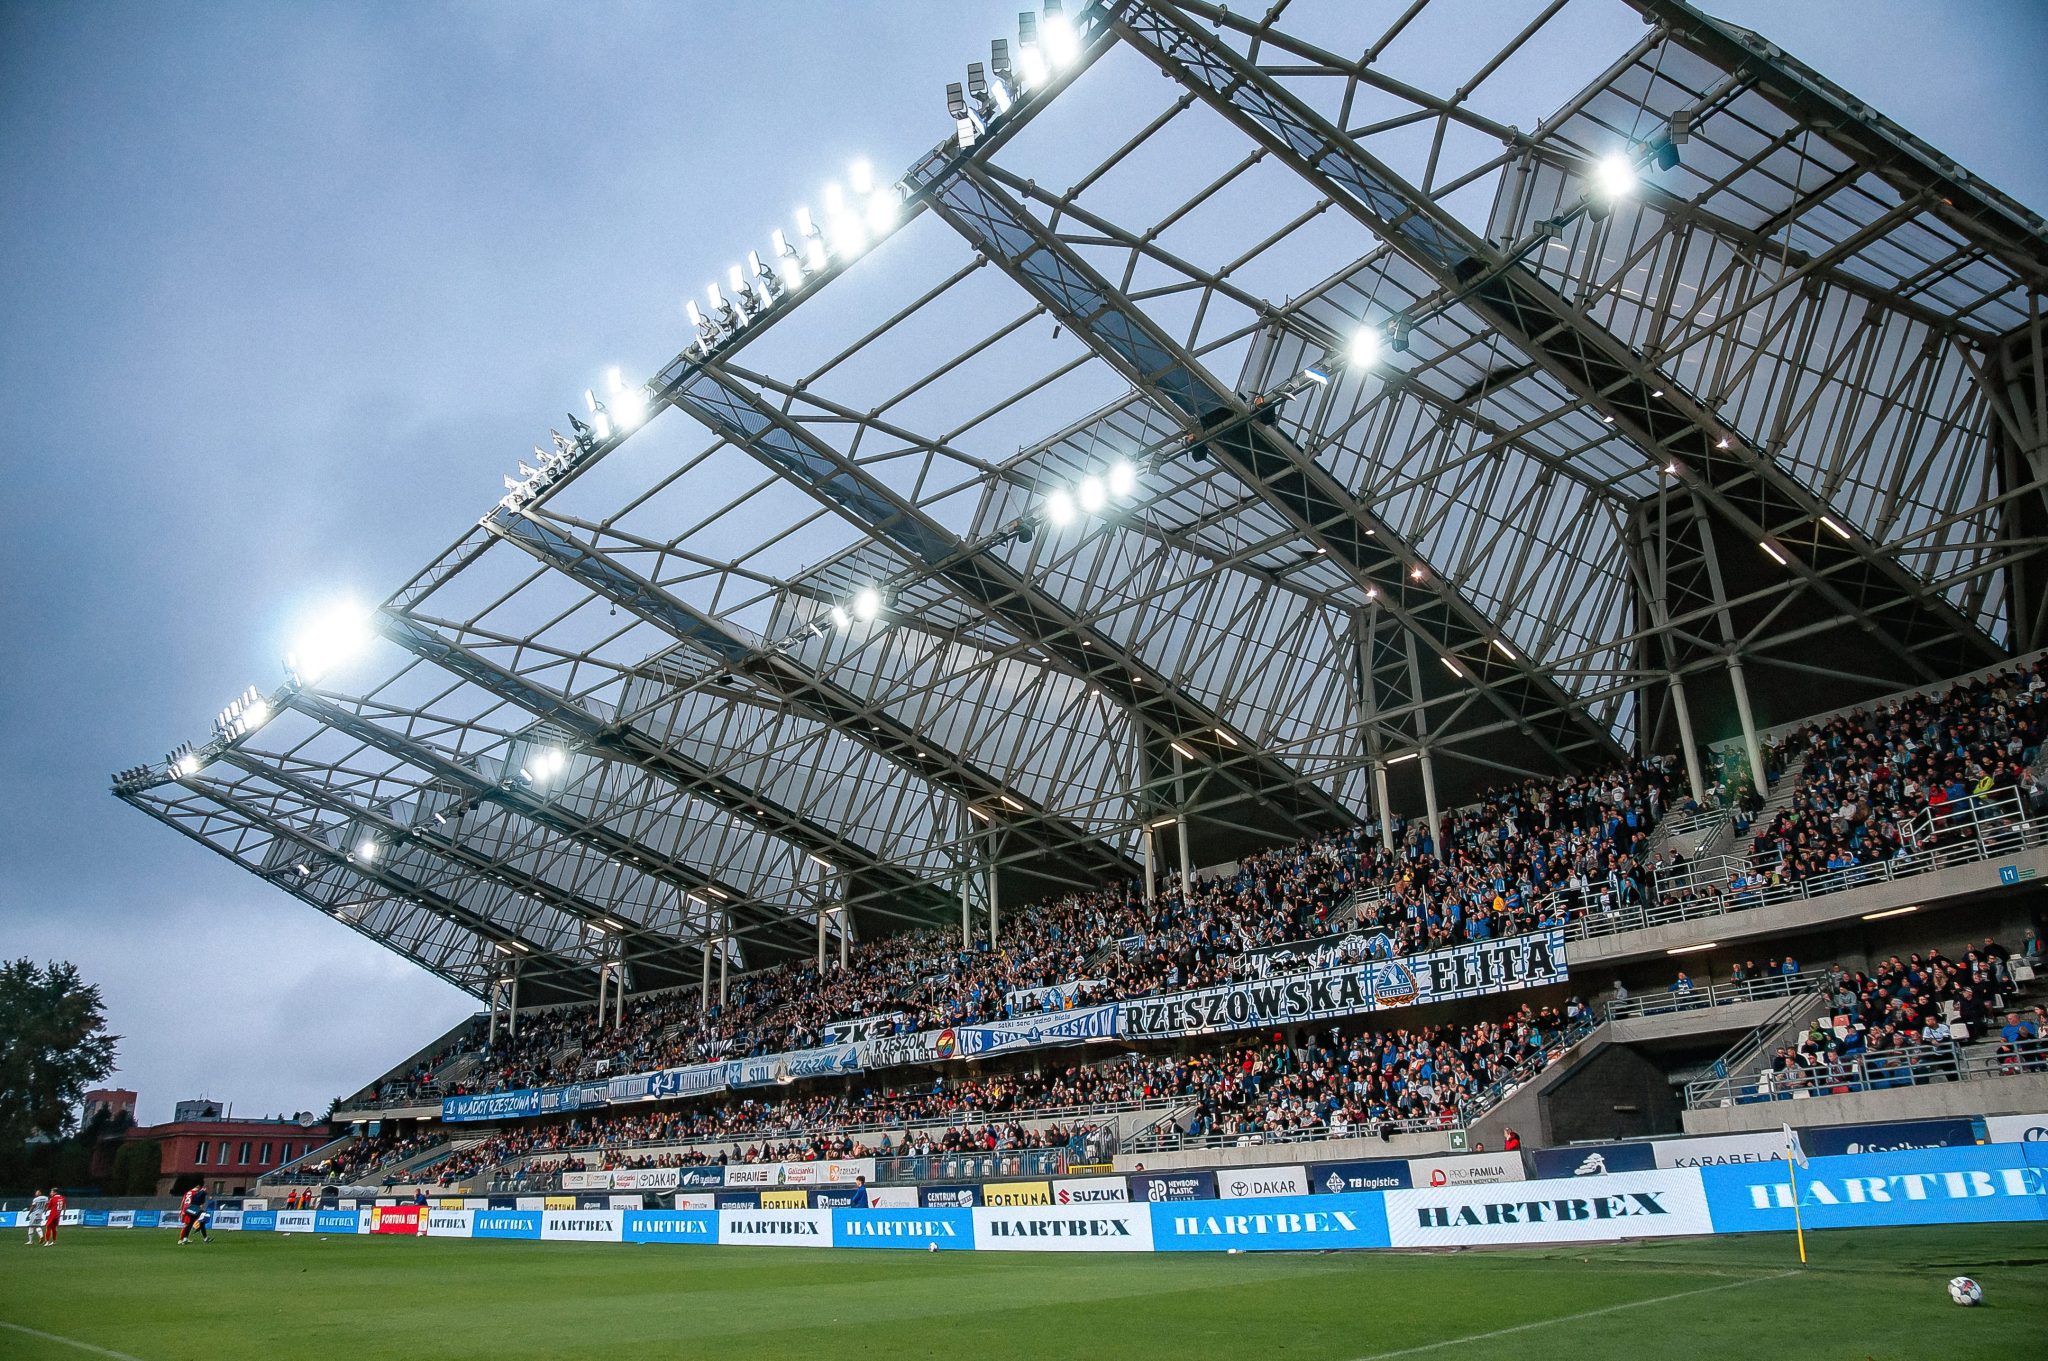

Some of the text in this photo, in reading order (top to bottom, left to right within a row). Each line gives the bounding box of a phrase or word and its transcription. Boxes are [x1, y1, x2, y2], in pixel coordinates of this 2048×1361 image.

[2003, 869, 2014, 881] 11
[1125, 940, 1558, 1035] RZESZOWSKA ELITA
[960, 1030, 983, 1055] ZKS
[992, 1031, 1022, 1046] STAL
[900, 1050, 911, 1063] OD
[913, 1048, 936, 1062] LGBT
[749, 1066, 769, 1082] STAL
[489, 1096, 531, 1114] RZESZOWA
[1675, 1152, 1783, 1168] KARABELA
[649, 1173, 677, 1187] DAKAR
[1168, 1179, 1199, 1187] NEWBORN
[1253, 1179, 1296, 1195] DAKAR
[1349, 1176, 1399, 1189] TB logistics
[1073, 1188, 1125, 1202] SUZUKI
[1169, 1187, 1193, 1195] PLASTIC
[1745, 1167, 2048, 1211] HARTBE
[927, 1192, 957, 1202] CENTRUM
[986, 1193, 1049, 1206] FORTUNA
[762, 1200, 806, 1209] FORTUNA
[1417, 1191, 1672, 1228] HARTBEX
[279, 1216, 312, 1226] HARTBEX
[318, 1216, 355, 1227] HARTBEX
[381, 1214, 405, 1224] FORTUNA
[429, 1218, 467, 1229] ARTBEX
[479, 1218, 534, 1231] HARTBEX
[549, 1220, 613, 1232] HARTBEX
[1175, 1210, 1361, 1236] HARTBEX
[632, 1220, 708, 1233] HARTBEX
[730, 1220, 819, 1235] HARTBEX
[846, 1220, 956, 1237] HARTBEX
[990, 1219, 1131, 1237] HARTBEX
